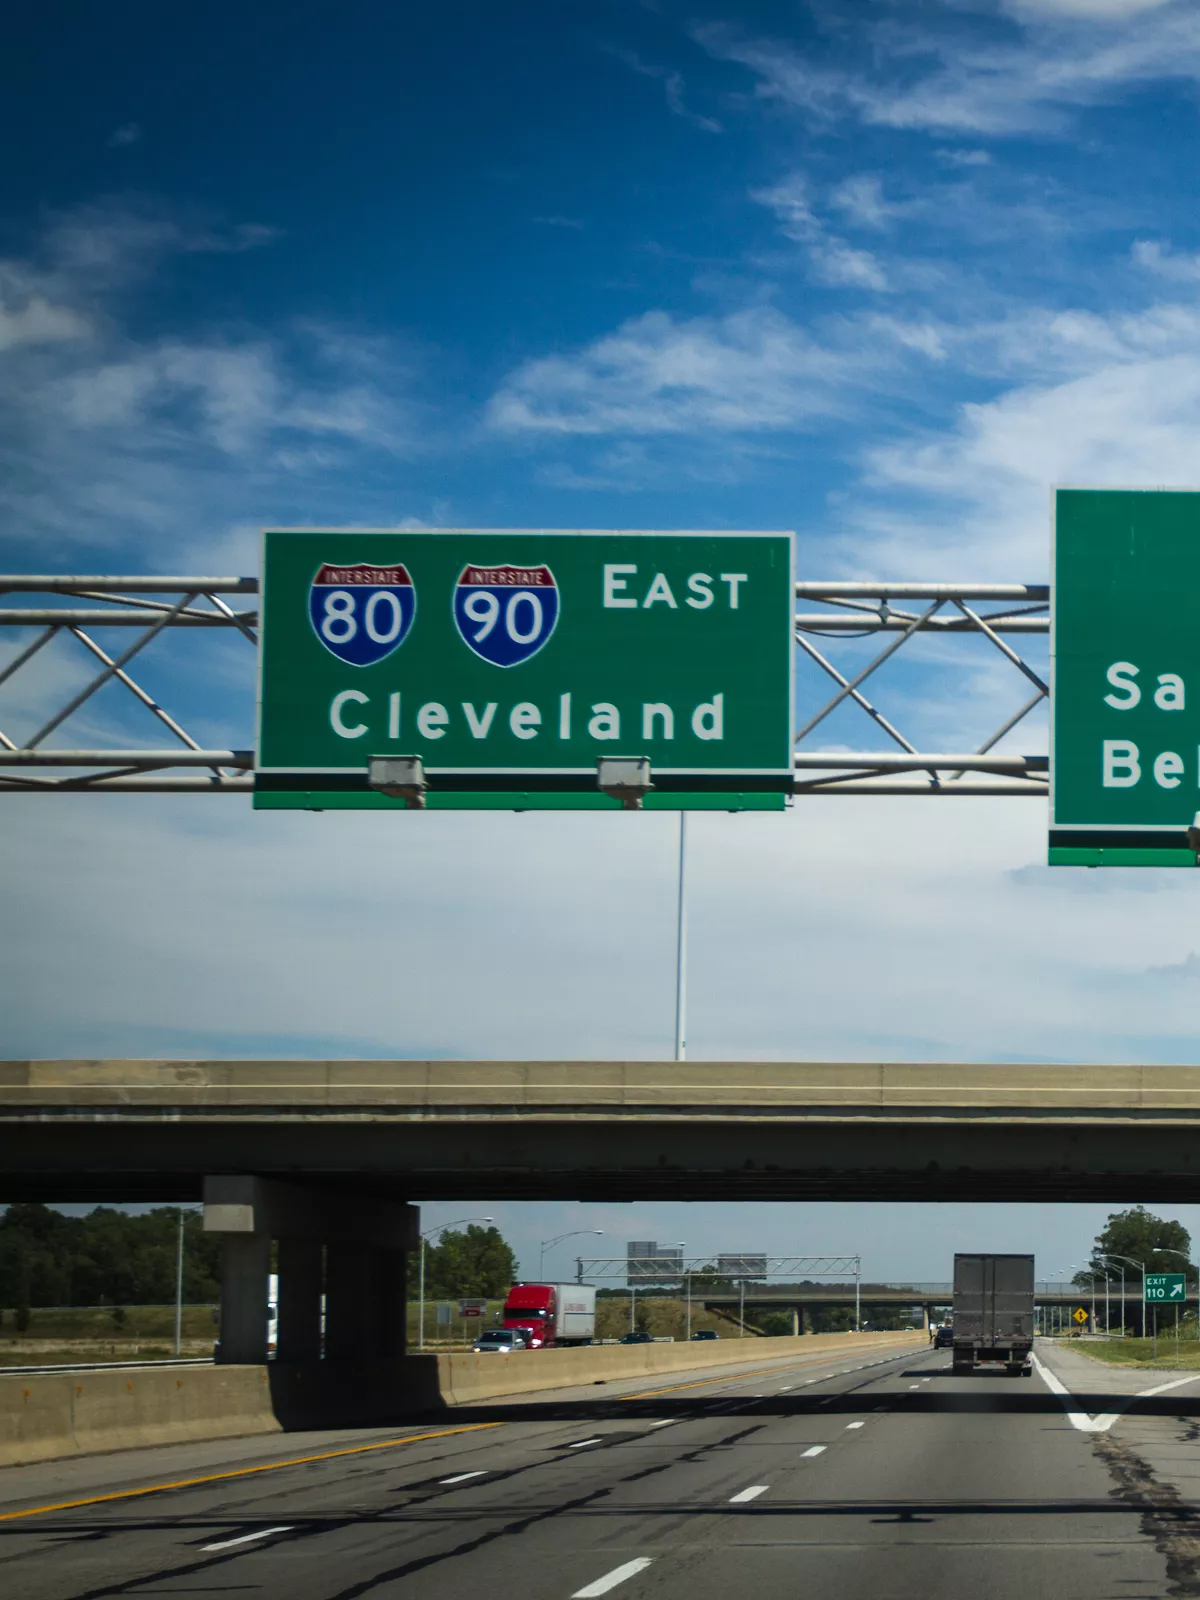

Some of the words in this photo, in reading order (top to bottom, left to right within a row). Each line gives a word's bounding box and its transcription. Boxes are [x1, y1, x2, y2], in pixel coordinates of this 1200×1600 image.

[325, 570, 400, 585] INTERSTATE
[470, 571, 544, 585] INTERSTATE
[603, 563, 748, 609] EAST
[321, 590, 402, 644] 80
[463, 590, 543, 645] 90
[330, 689, 723, 741] Cleveland
[1146, 1288, 1165, 1298] 110
